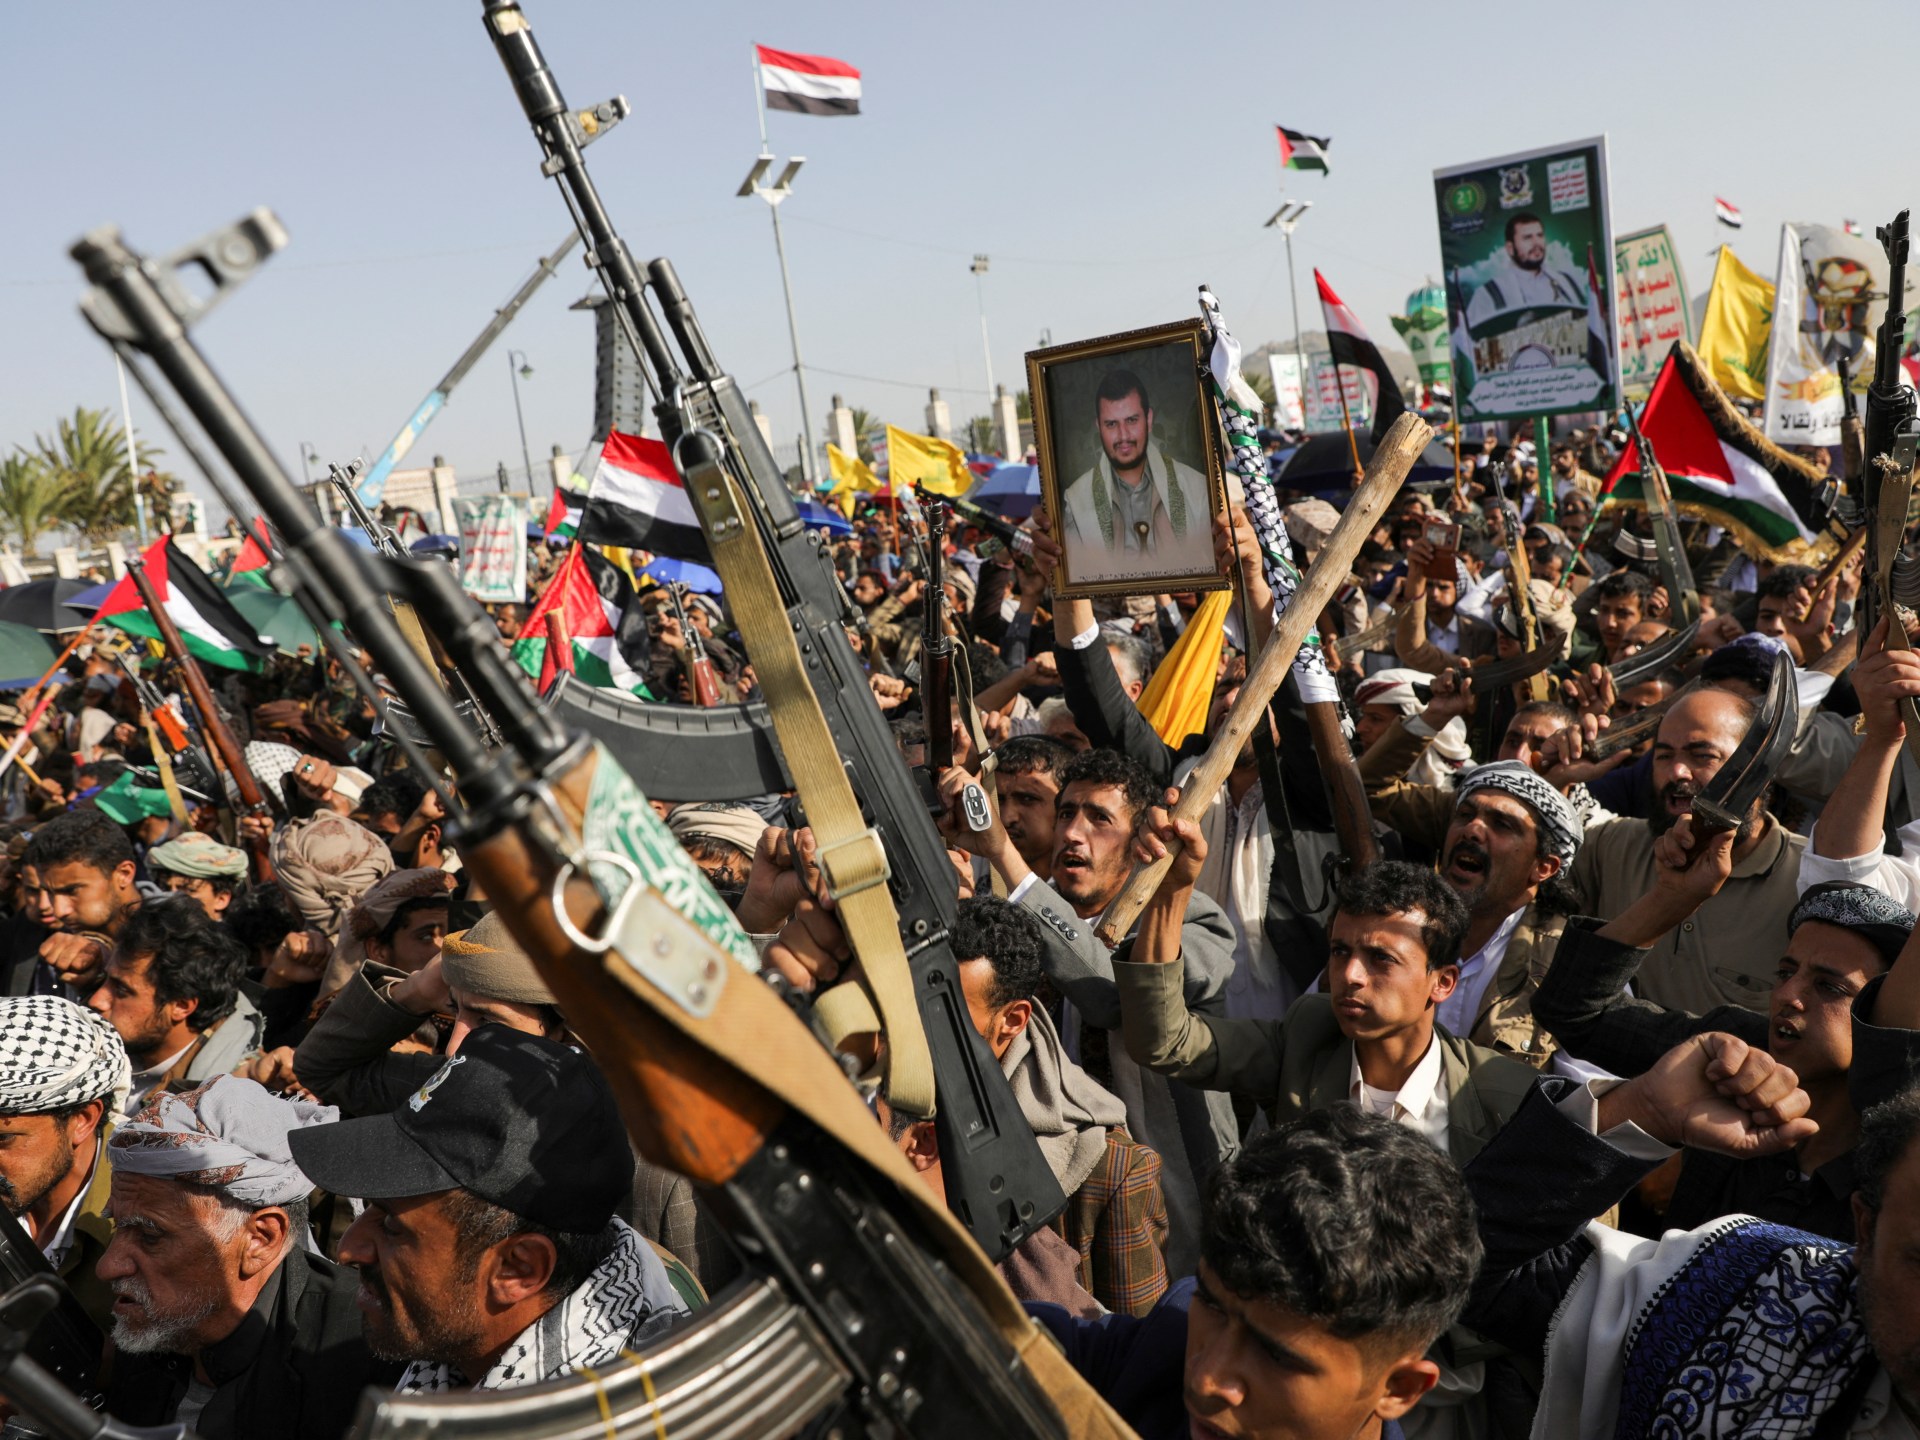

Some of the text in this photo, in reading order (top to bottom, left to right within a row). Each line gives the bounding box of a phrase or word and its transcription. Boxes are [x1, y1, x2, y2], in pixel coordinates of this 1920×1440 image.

[1456, 189, 1473, 205] 21
[1637, 243, 1668, 268] الله
[1638, 272, 1675, 294] الموت
[1642, 296, 1681, 321] الموت
